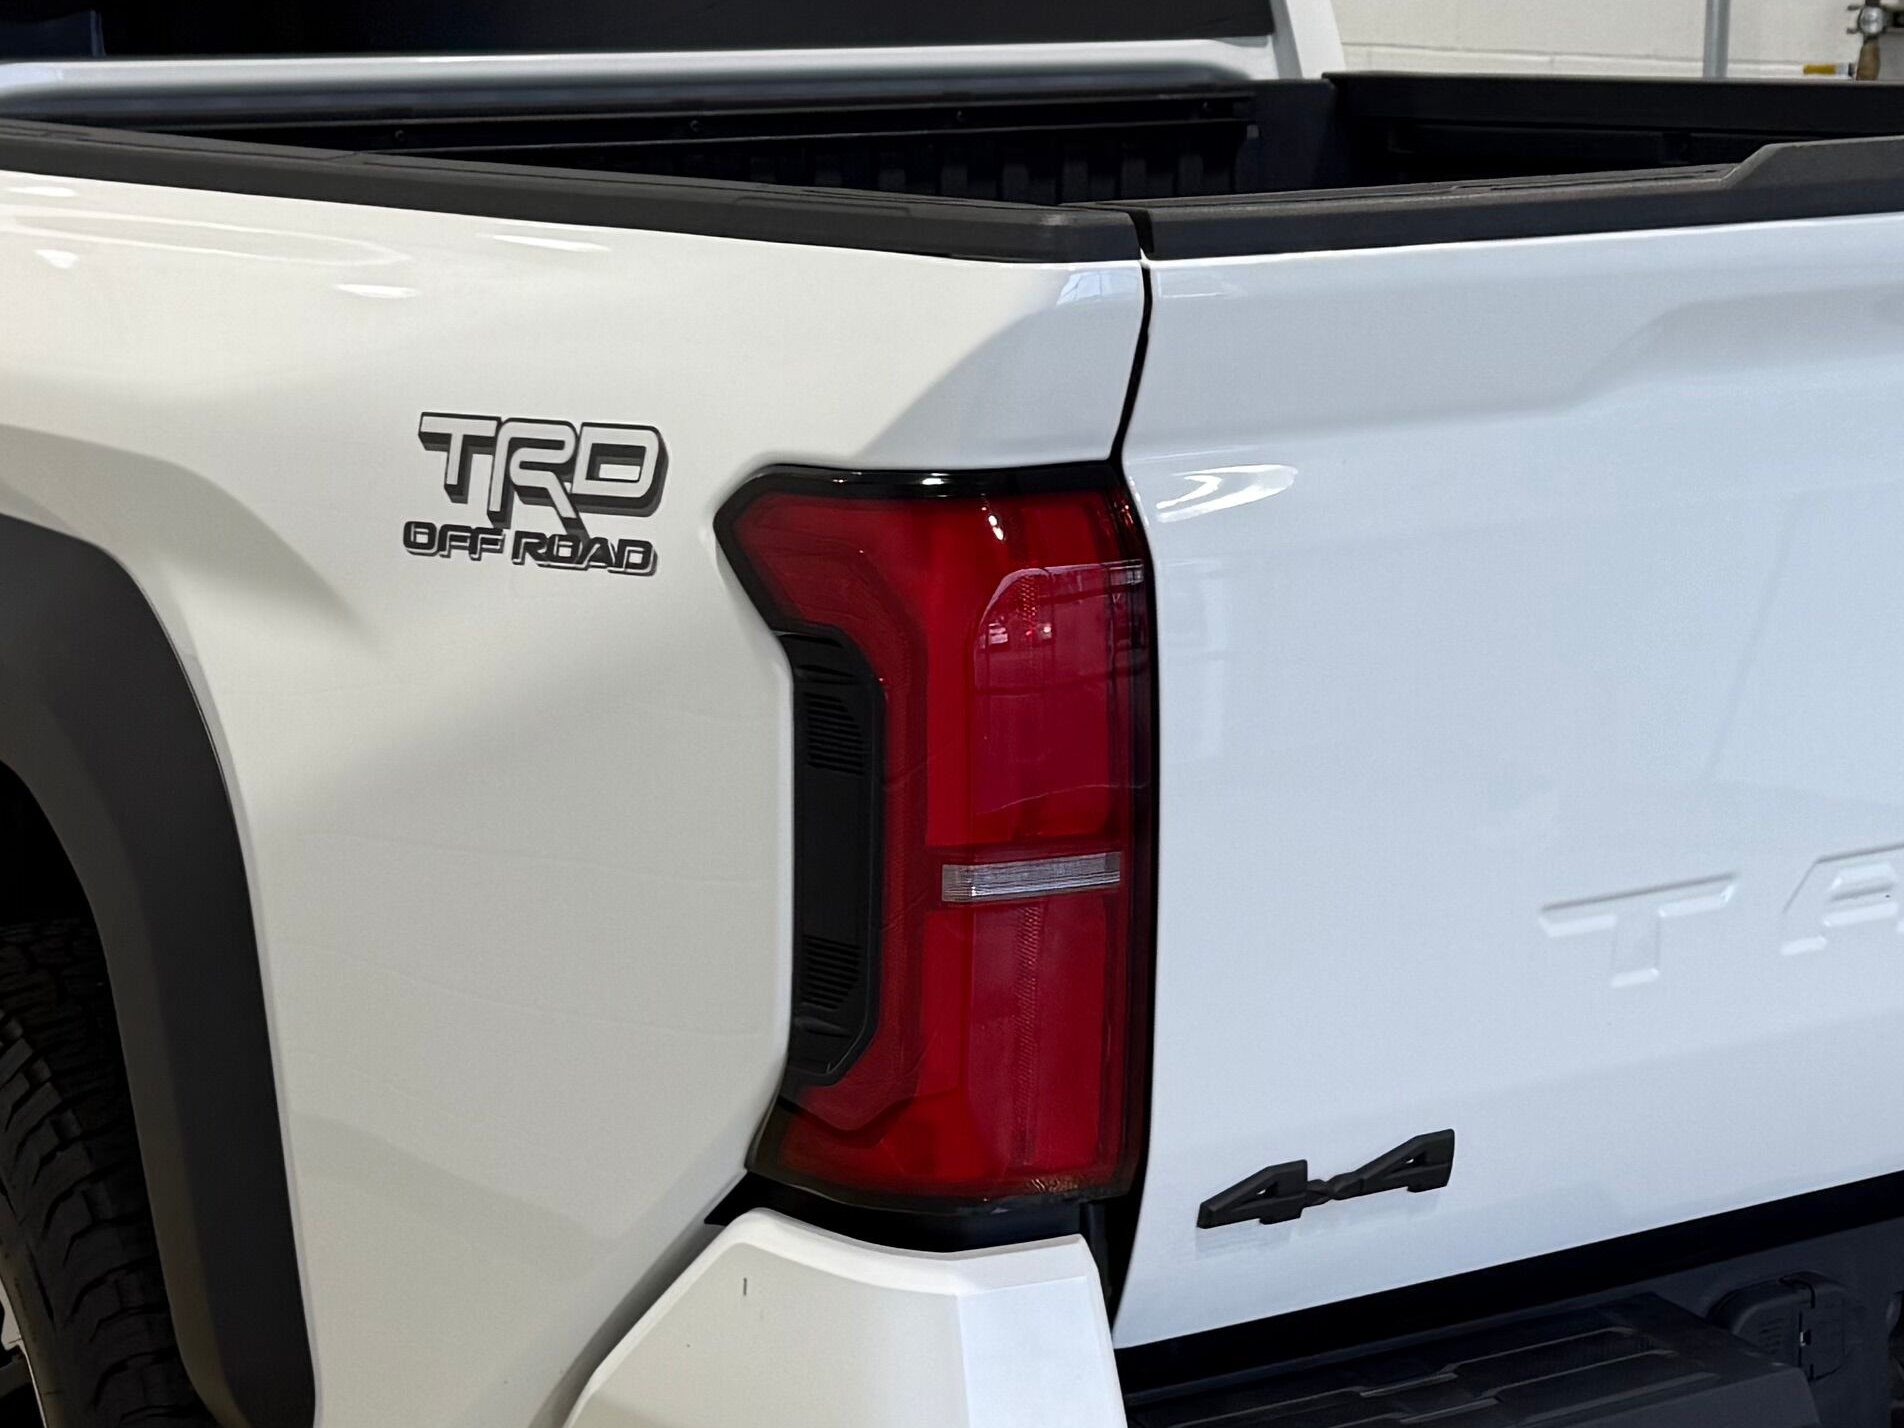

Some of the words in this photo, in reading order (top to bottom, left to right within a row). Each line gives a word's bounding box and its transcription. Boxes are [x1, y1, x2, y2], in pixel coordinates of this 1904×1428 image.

[418, 411, 669, 537] TRD
[402, 520, 506, 562] OFF
[511, 529, 659, 577] ROAD
